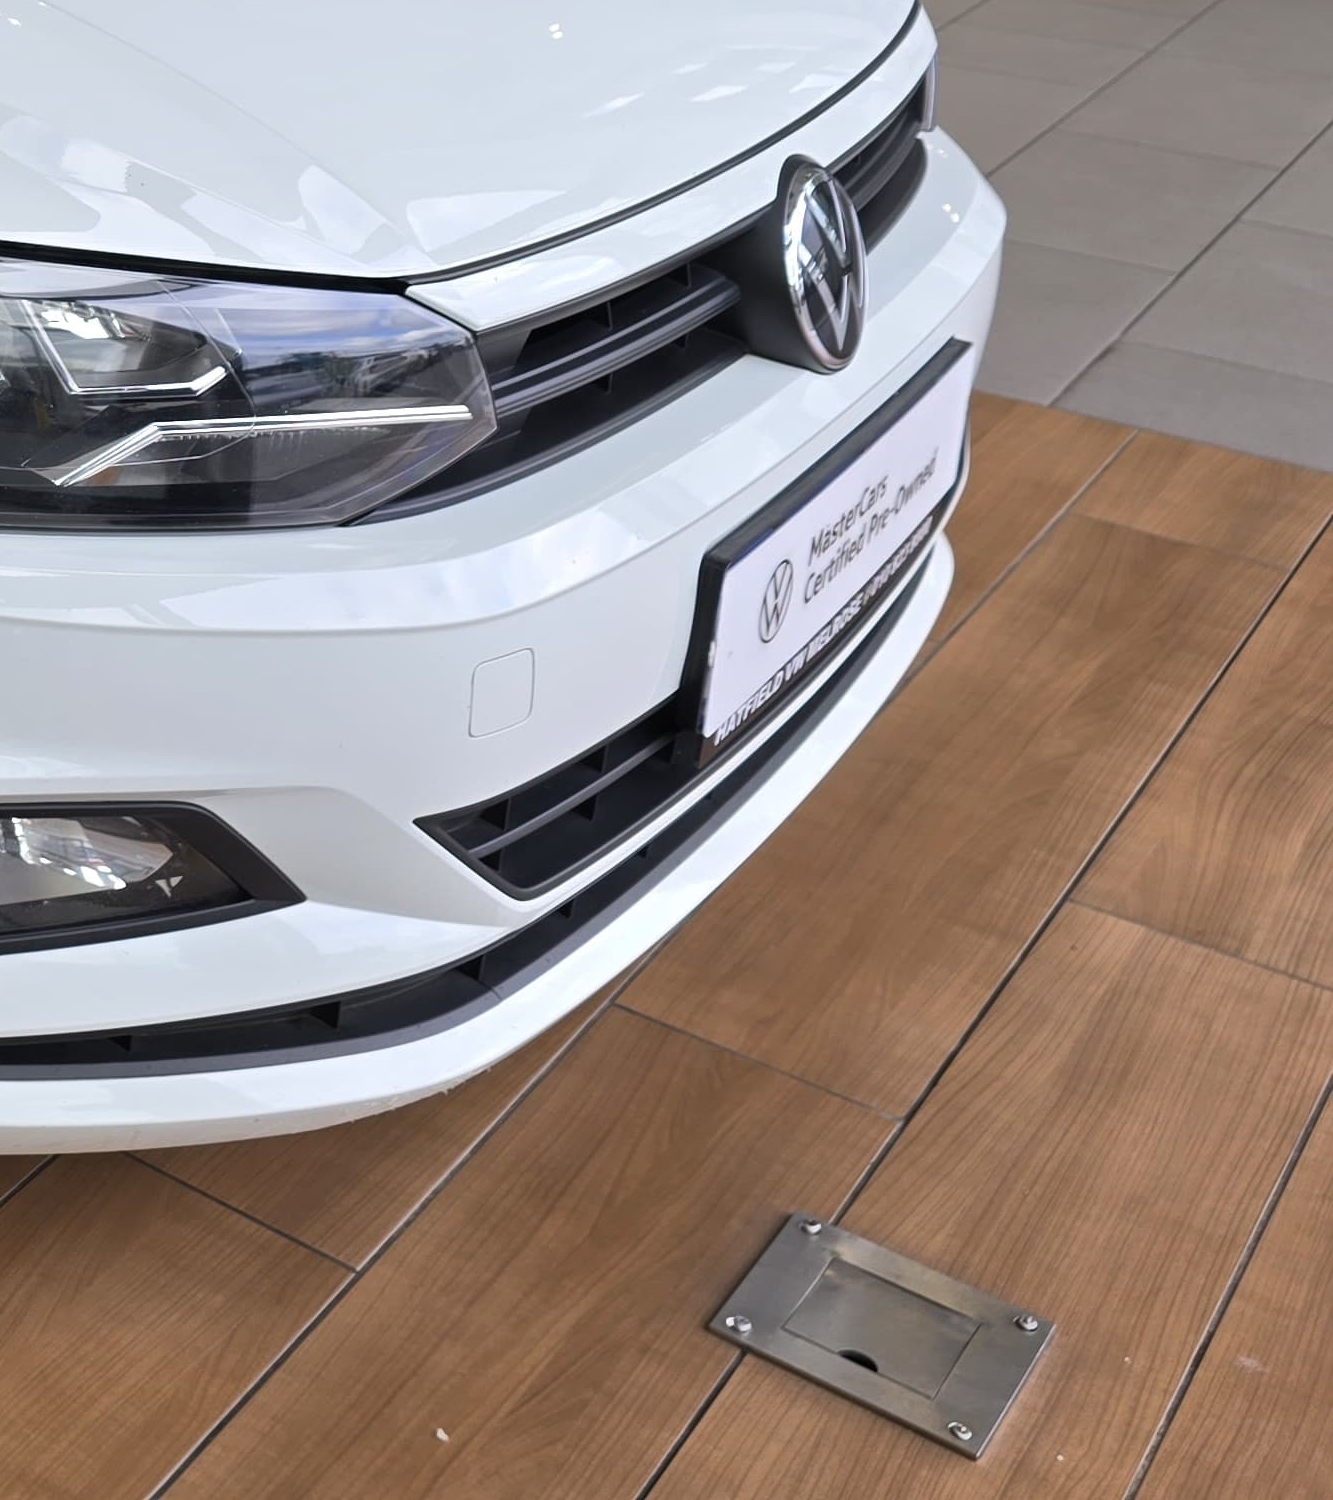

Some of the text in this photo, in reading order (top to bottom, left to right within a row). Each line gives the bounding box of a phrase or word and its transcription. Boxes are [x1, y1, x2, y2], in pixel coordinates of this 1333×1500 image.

[803, 523, 867, 605] Certified
[867, 446, 937, 545] Pre-Owned
[807, 473, 890, 566] MasterCars
[713, 669, 784, 746] HATFIELD
[806, 591, 866, 663] MELROSE
